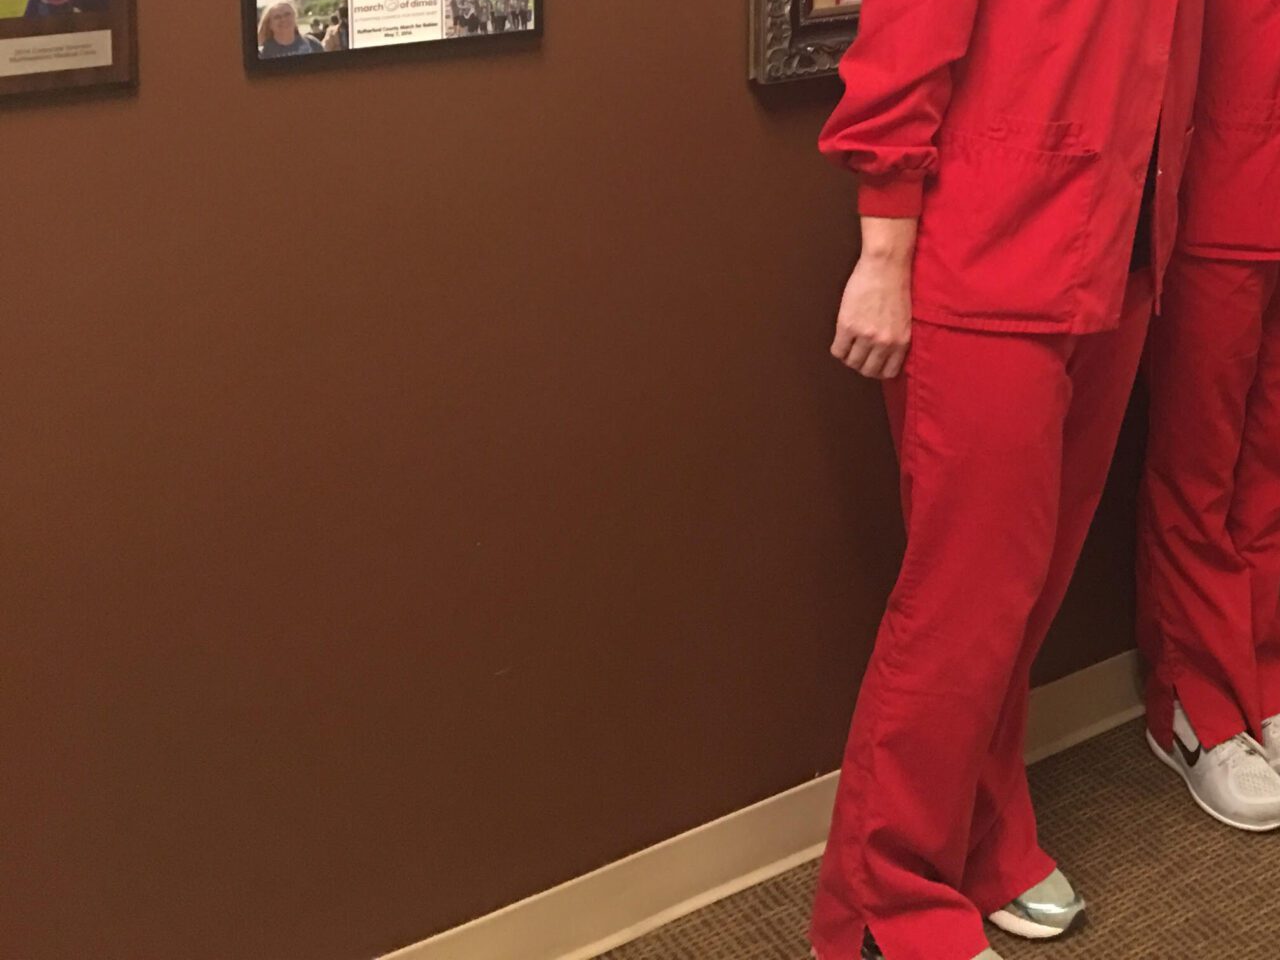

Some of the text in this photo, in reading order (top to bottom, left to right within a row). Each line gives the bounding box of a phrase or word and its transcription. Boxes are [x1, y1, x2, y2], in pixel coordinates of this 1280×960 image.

[354, 0, 438, 13] march of dimes
